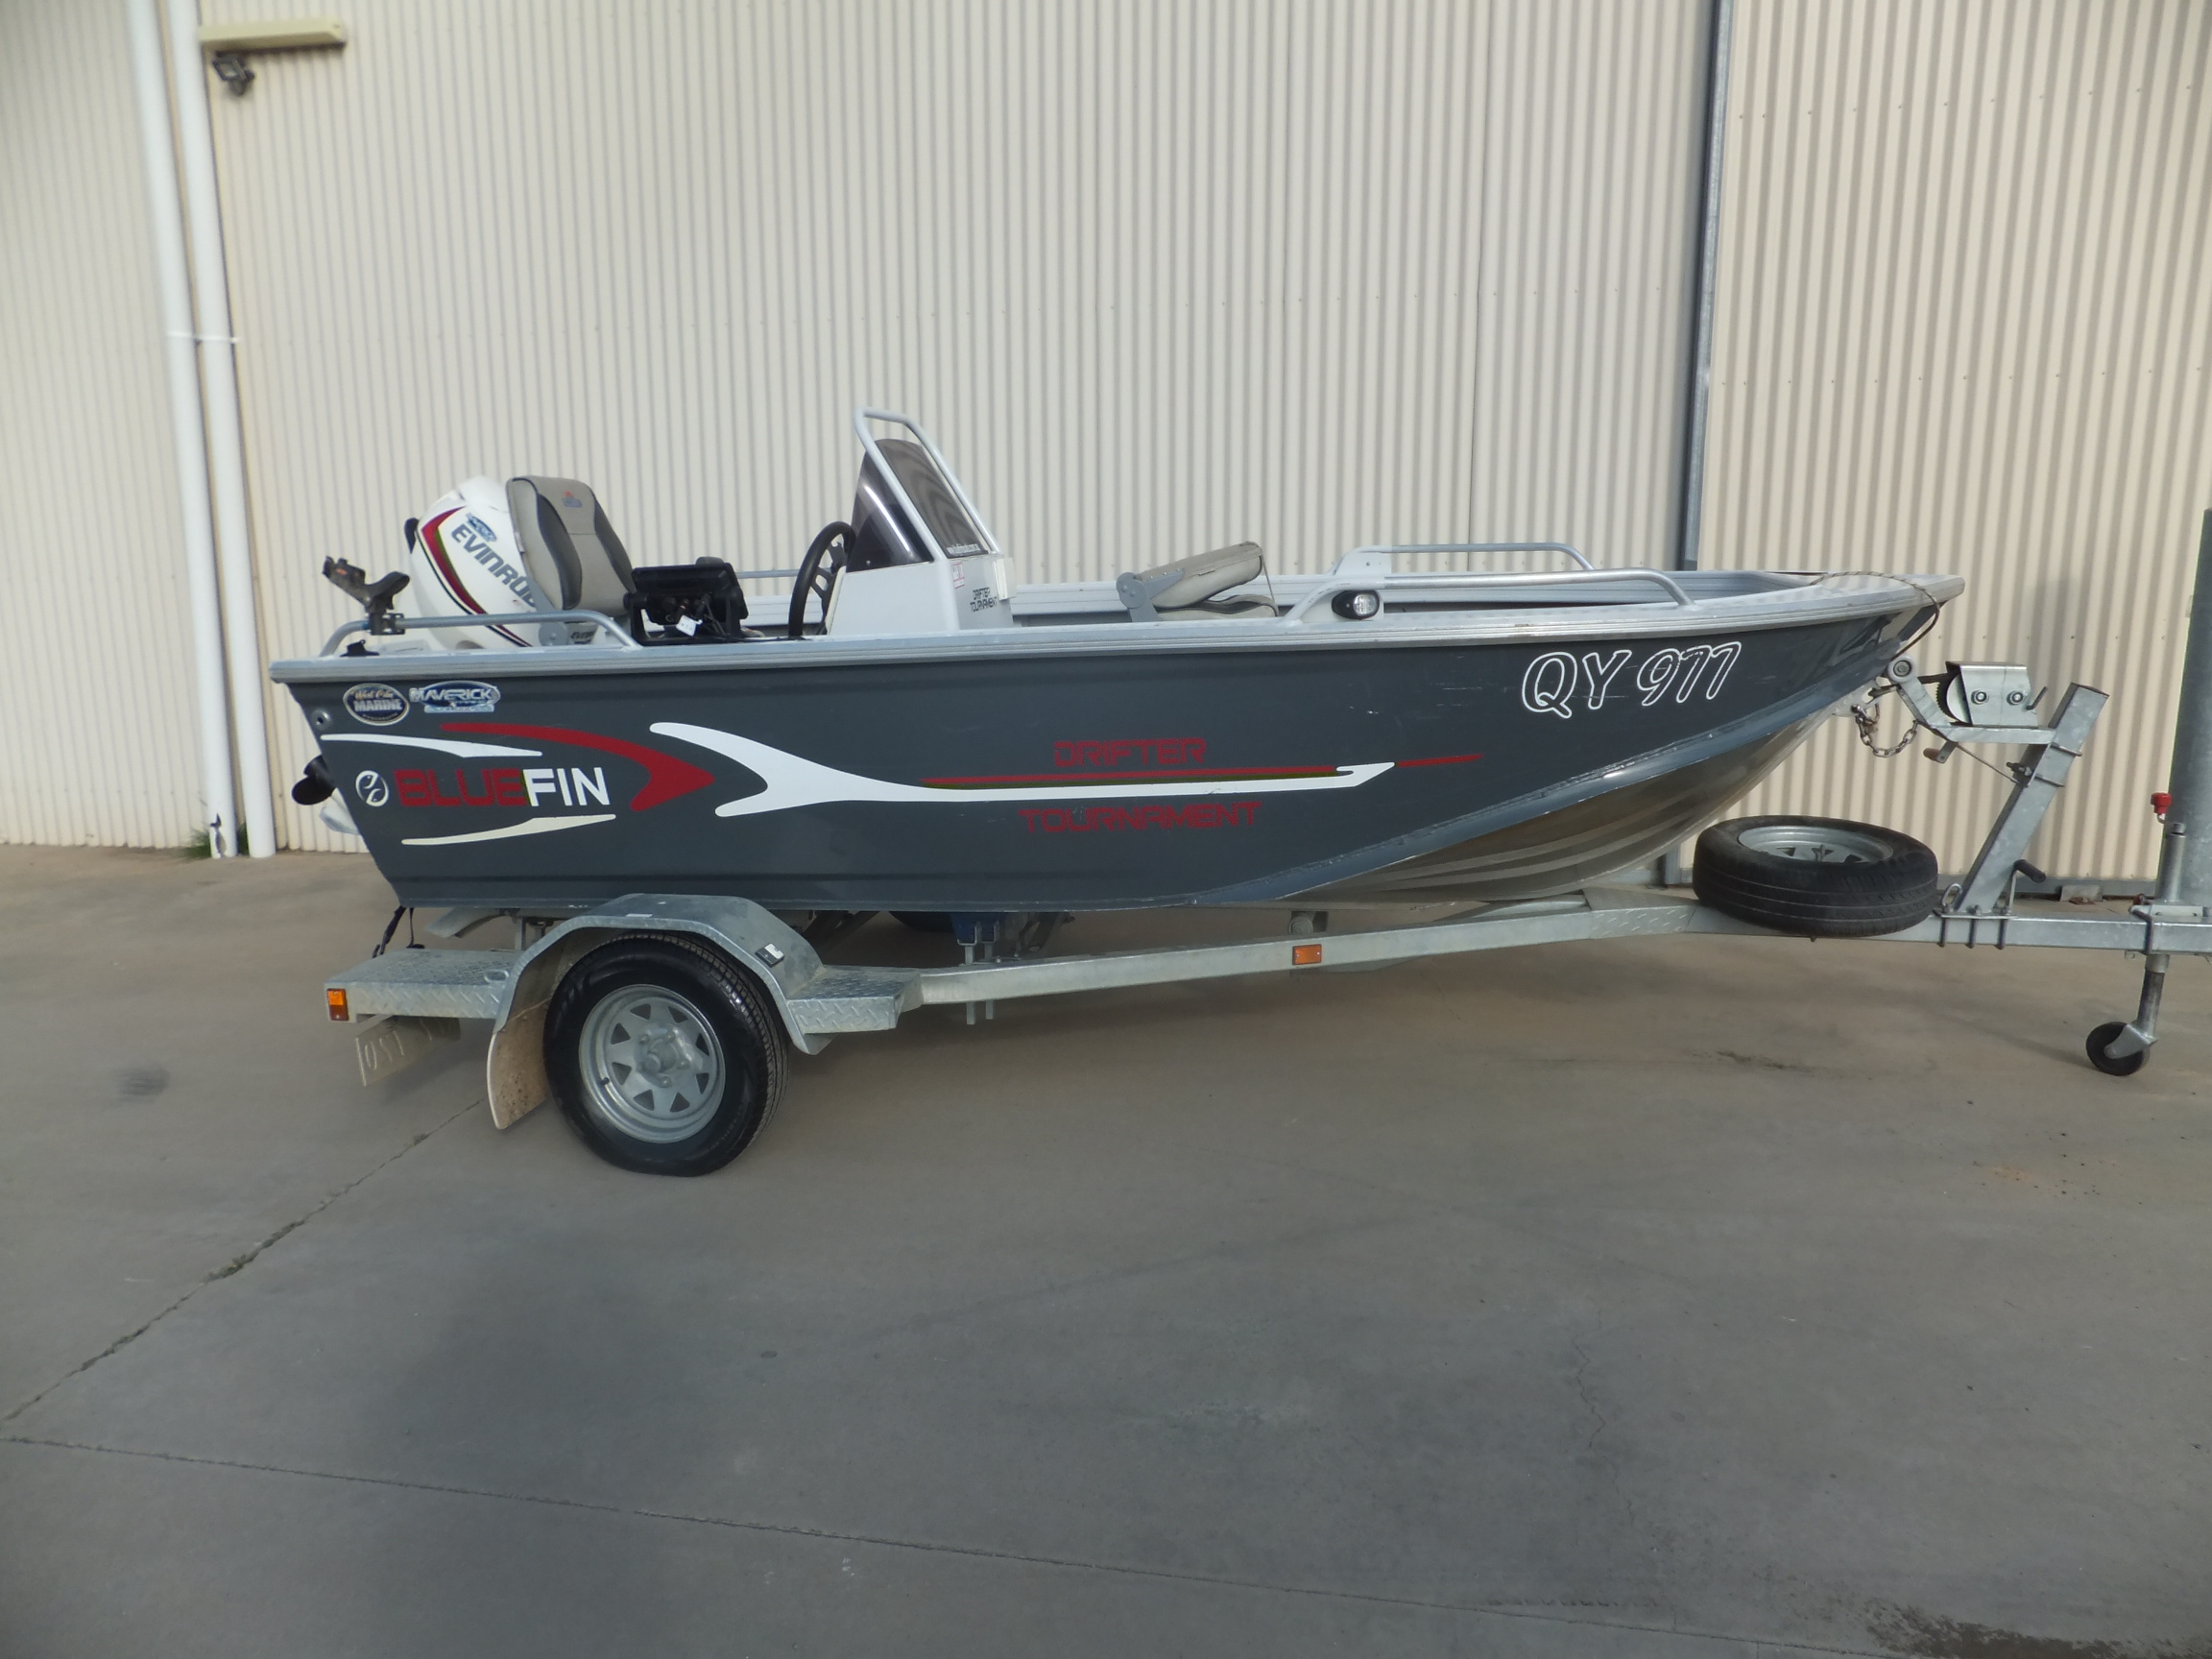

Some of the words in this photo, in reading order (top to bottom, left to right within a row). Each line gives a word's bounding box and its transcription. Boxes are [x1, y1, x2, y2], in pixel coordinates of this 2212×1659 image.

[409, 687, 493, 703] MAVERICK
[1522, 650, 1632, 718] QY
[1637, 641, 1742, 706] 977
[354, 700, 403, 711] MARINE
[1053, 736, 1207, 768] DRIFTER
[394, 767, 611, 807] BLUEFIN
[1018, 801, 1262, 833] TOURNAMENT
